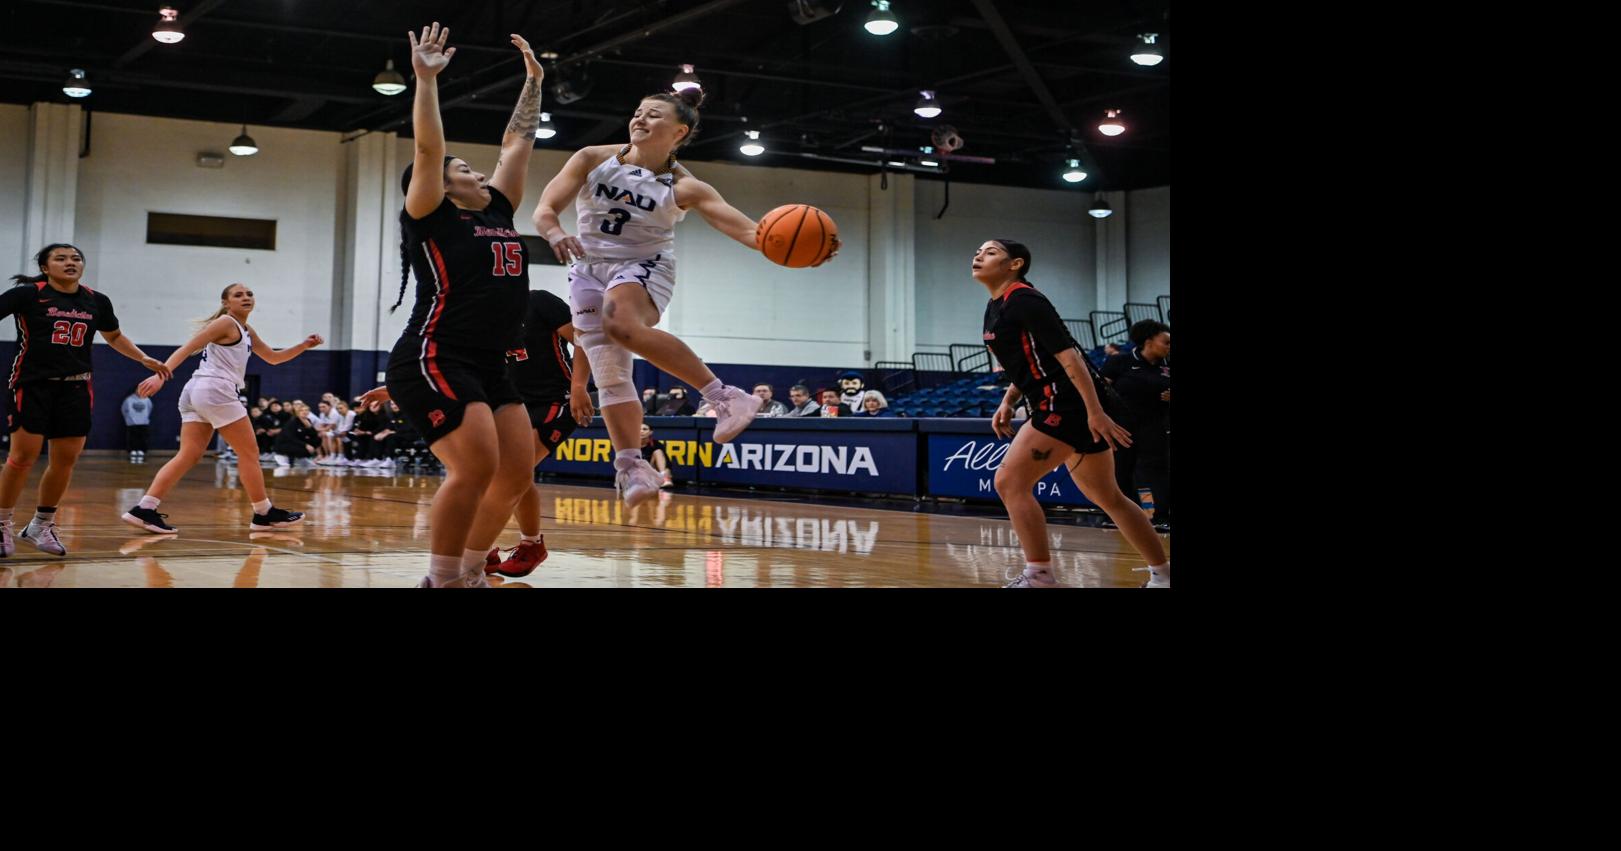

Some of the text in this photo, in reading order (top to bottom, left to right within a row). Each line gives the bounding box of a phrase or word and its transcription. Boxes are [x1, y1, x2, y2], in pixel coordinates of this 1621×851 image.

[595, 183, 657, 212] NAU
[600, 207, 632, 236] 3
[490, 241, 523, 277] 15
[51, 320, 88, 347] 20
[555, 438, 880, 476] NORRN ARIZONA
